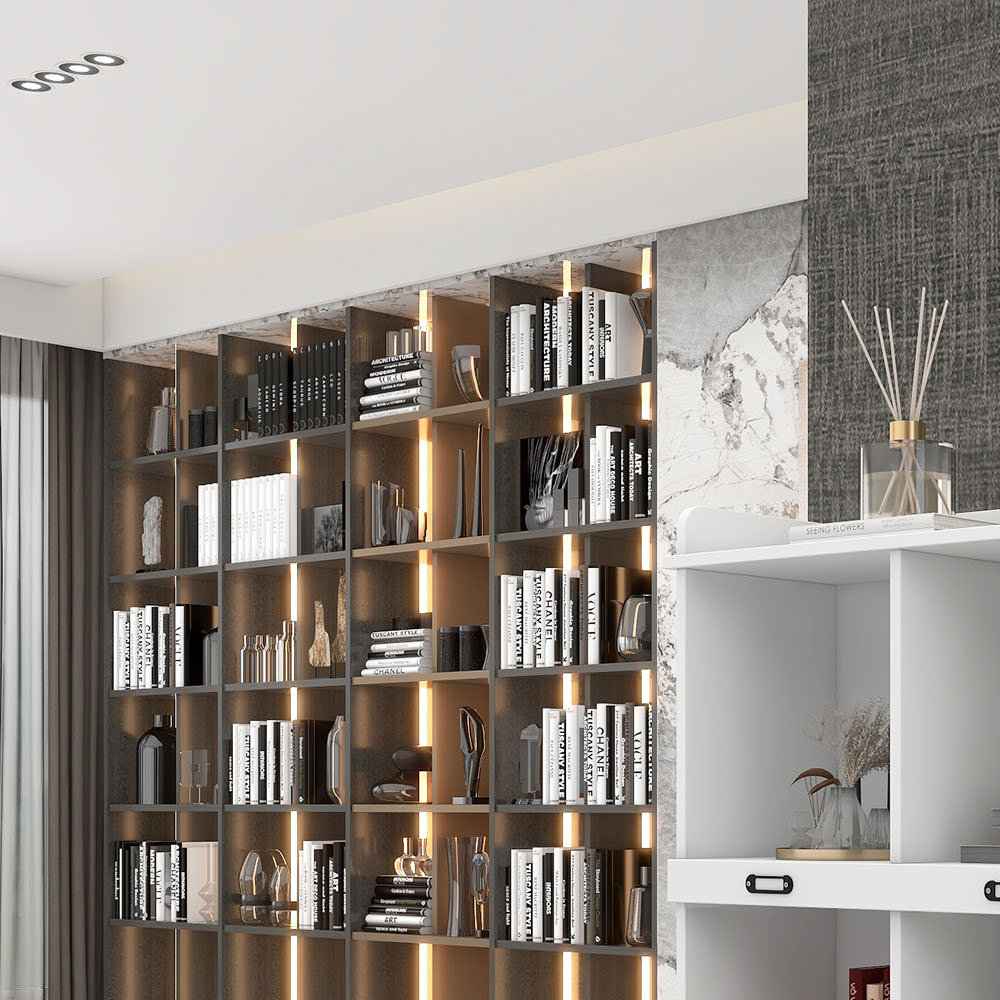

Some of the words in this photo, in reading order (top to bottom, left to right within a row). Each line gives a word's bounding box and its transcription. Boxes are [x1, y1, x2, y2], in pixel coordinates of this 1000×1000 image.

[634, 452, 642, 475] ART
[806, 525, 831, 535] SEEING
[833, 523, 865, 533] FLOWERS
[373, 668, 405, 676] CHANEL
[596, 727, 604, 781] CHANEL
